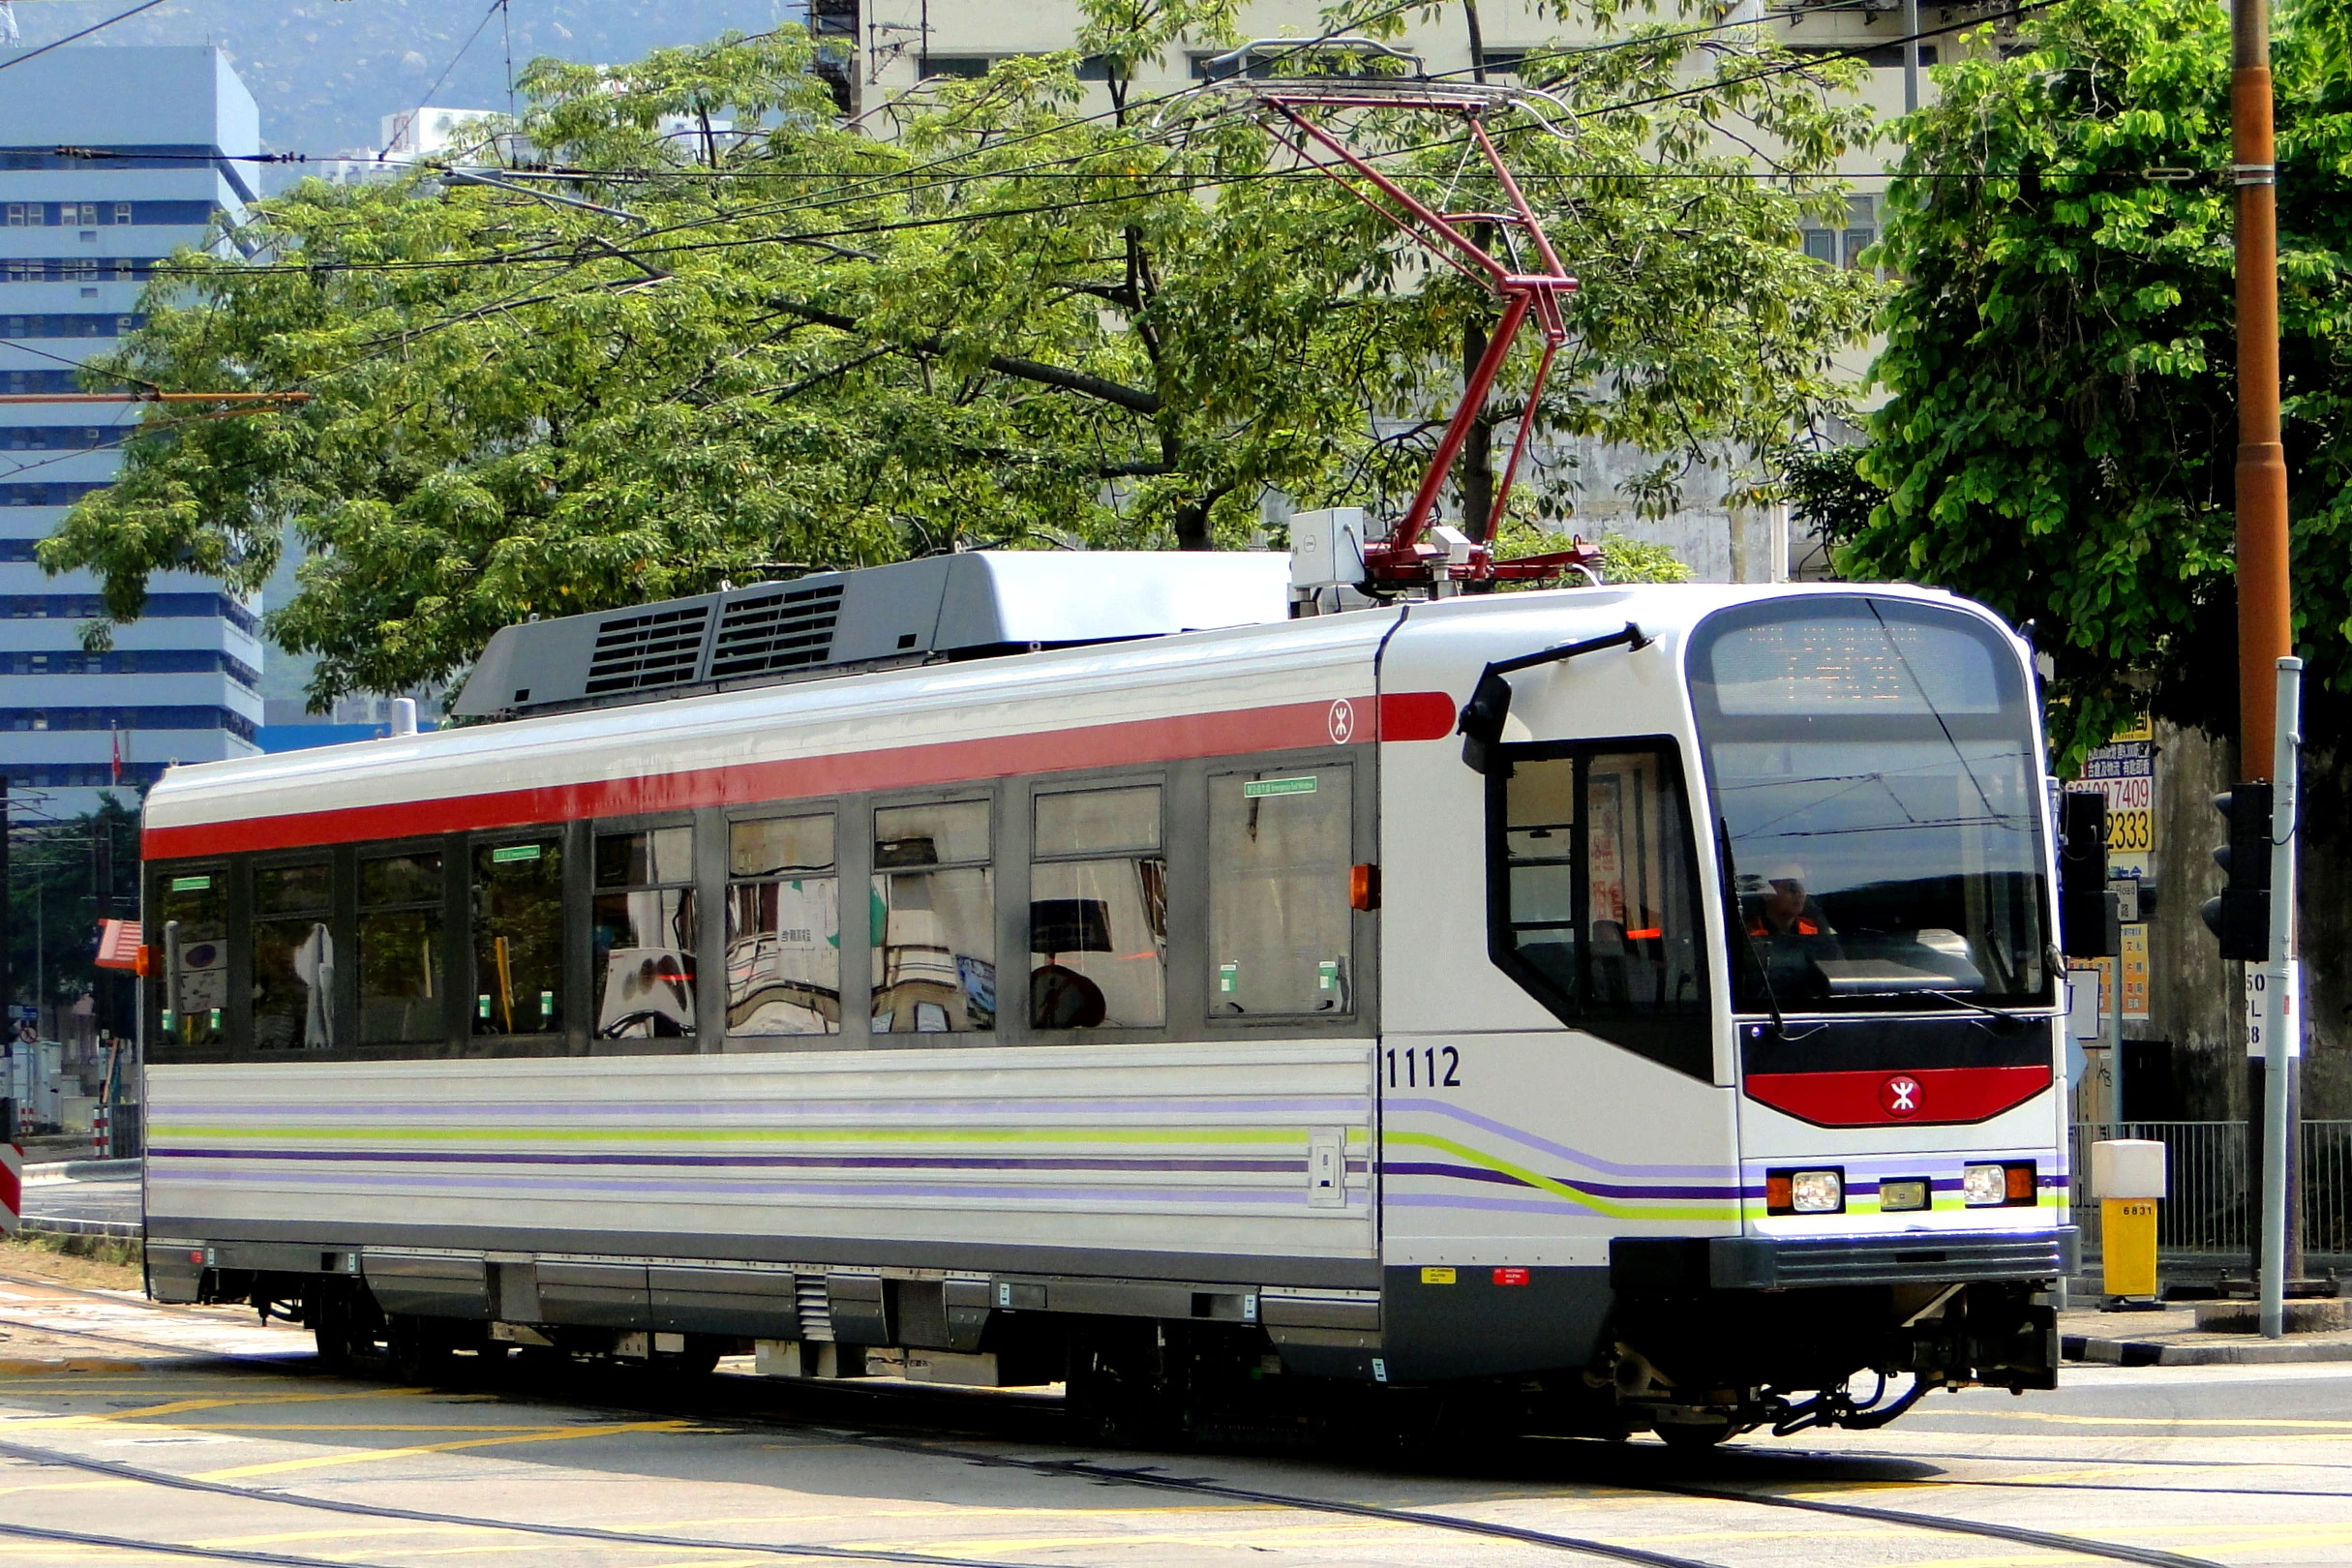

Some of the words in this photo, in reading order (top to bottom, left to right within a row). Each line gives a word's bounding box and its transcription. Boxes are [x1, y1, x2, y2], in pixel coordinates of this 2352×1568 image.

[2114, 779, 2149, 809] 7409
[1386, 1045, 1461, 1087] 1112
[2124, 1206, 2152, 1216] 6831
